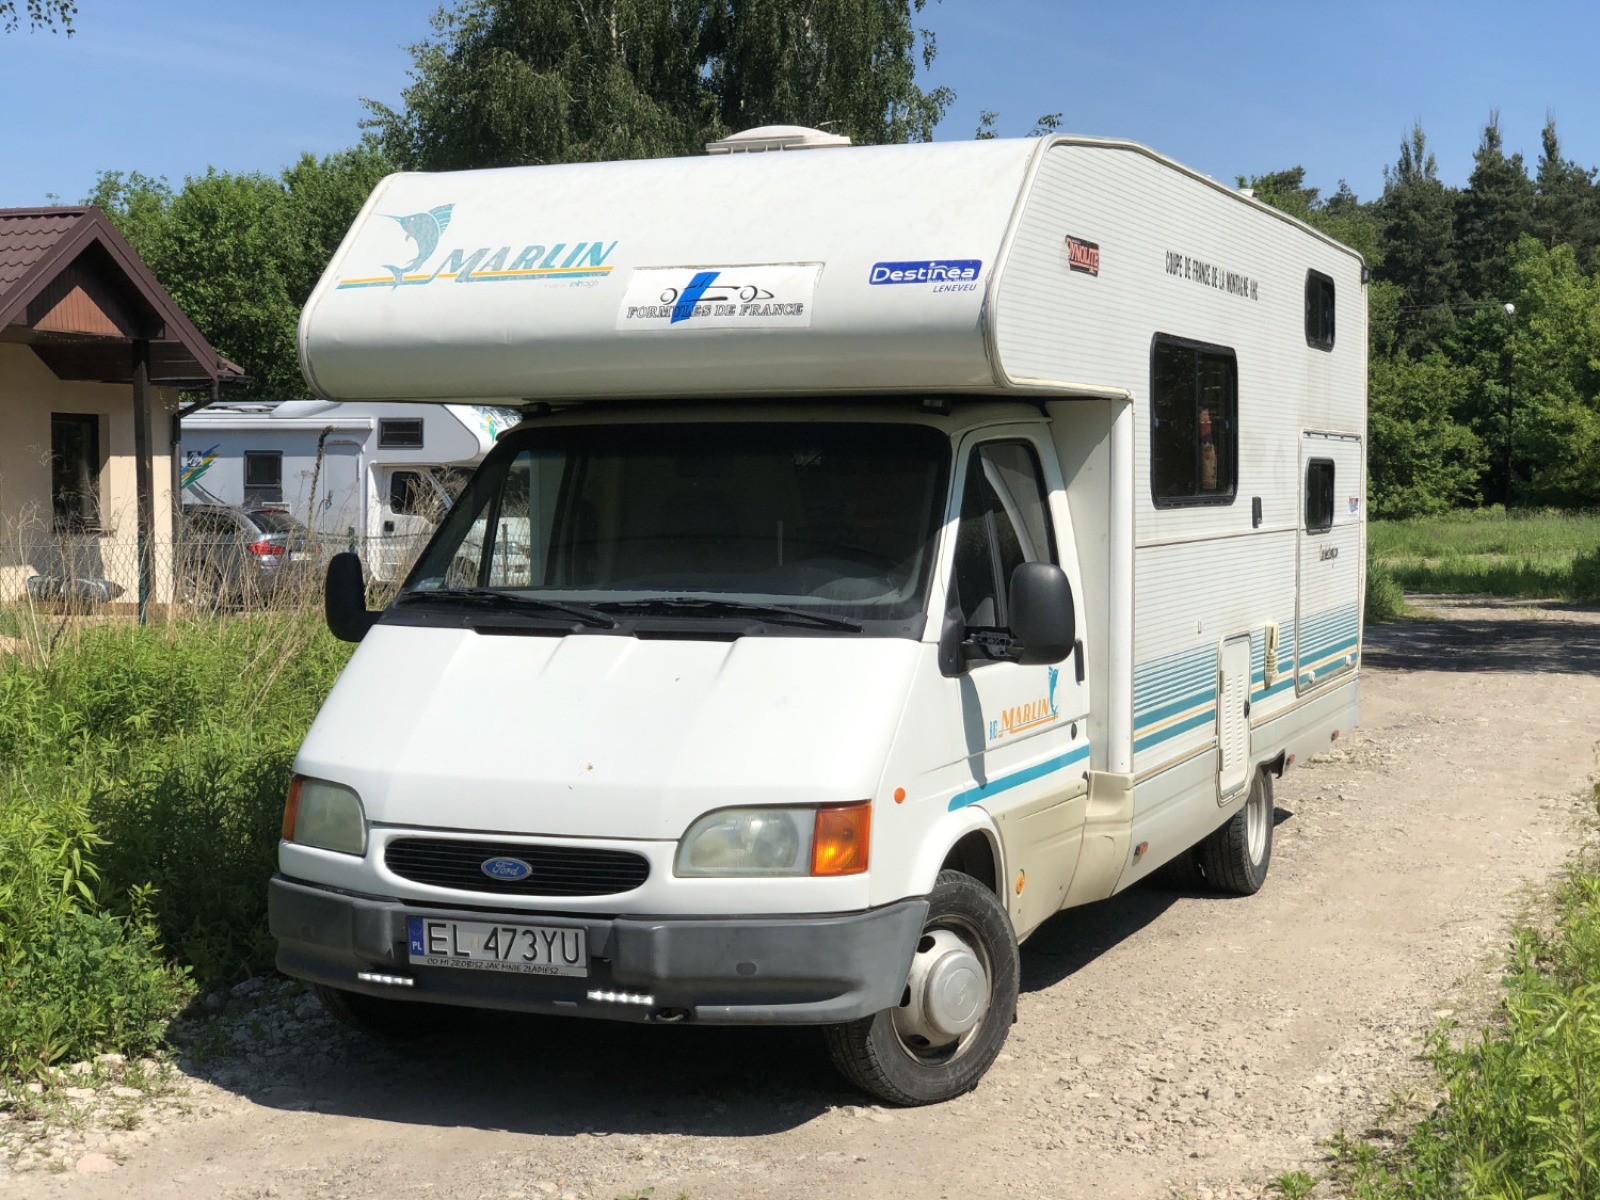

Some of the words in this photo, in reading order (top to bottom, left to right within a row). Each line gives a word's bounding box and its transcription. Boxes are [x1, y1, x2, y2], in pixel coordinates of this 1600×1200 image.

[440, 240, 618, 283] MARLIN
[1165, 250, 1182, 278] COUPE
[1184, 256, 1191, 280] DE
[1192, 259, 1211, 286] FRANCE
[1211, 265, 1218, 289] DE
[1218, 268, 1225, 291] LA
[932, 283, 978, 293] LENEVEU
[626, 303, 712, 319] FORMULES
[714, 304, 736, 317] DE
[739, 303, 804, 317] FRANCE
[1002, 698, 1049, 735] MARLIN
[491, 861, 520, 876] Ford
[412, 940, 423, 950] PL
[427, 922, 471, 958] EL
[483, 926, 580, 964] 473YU
[427, 957, 438, 966] CO
[440, 958, 449, 967] MI
[450, 959, 484, 970] ZROBISZ
[485, 962, 500, 971] JAK
[501, 963, 522, 973] MNIE
